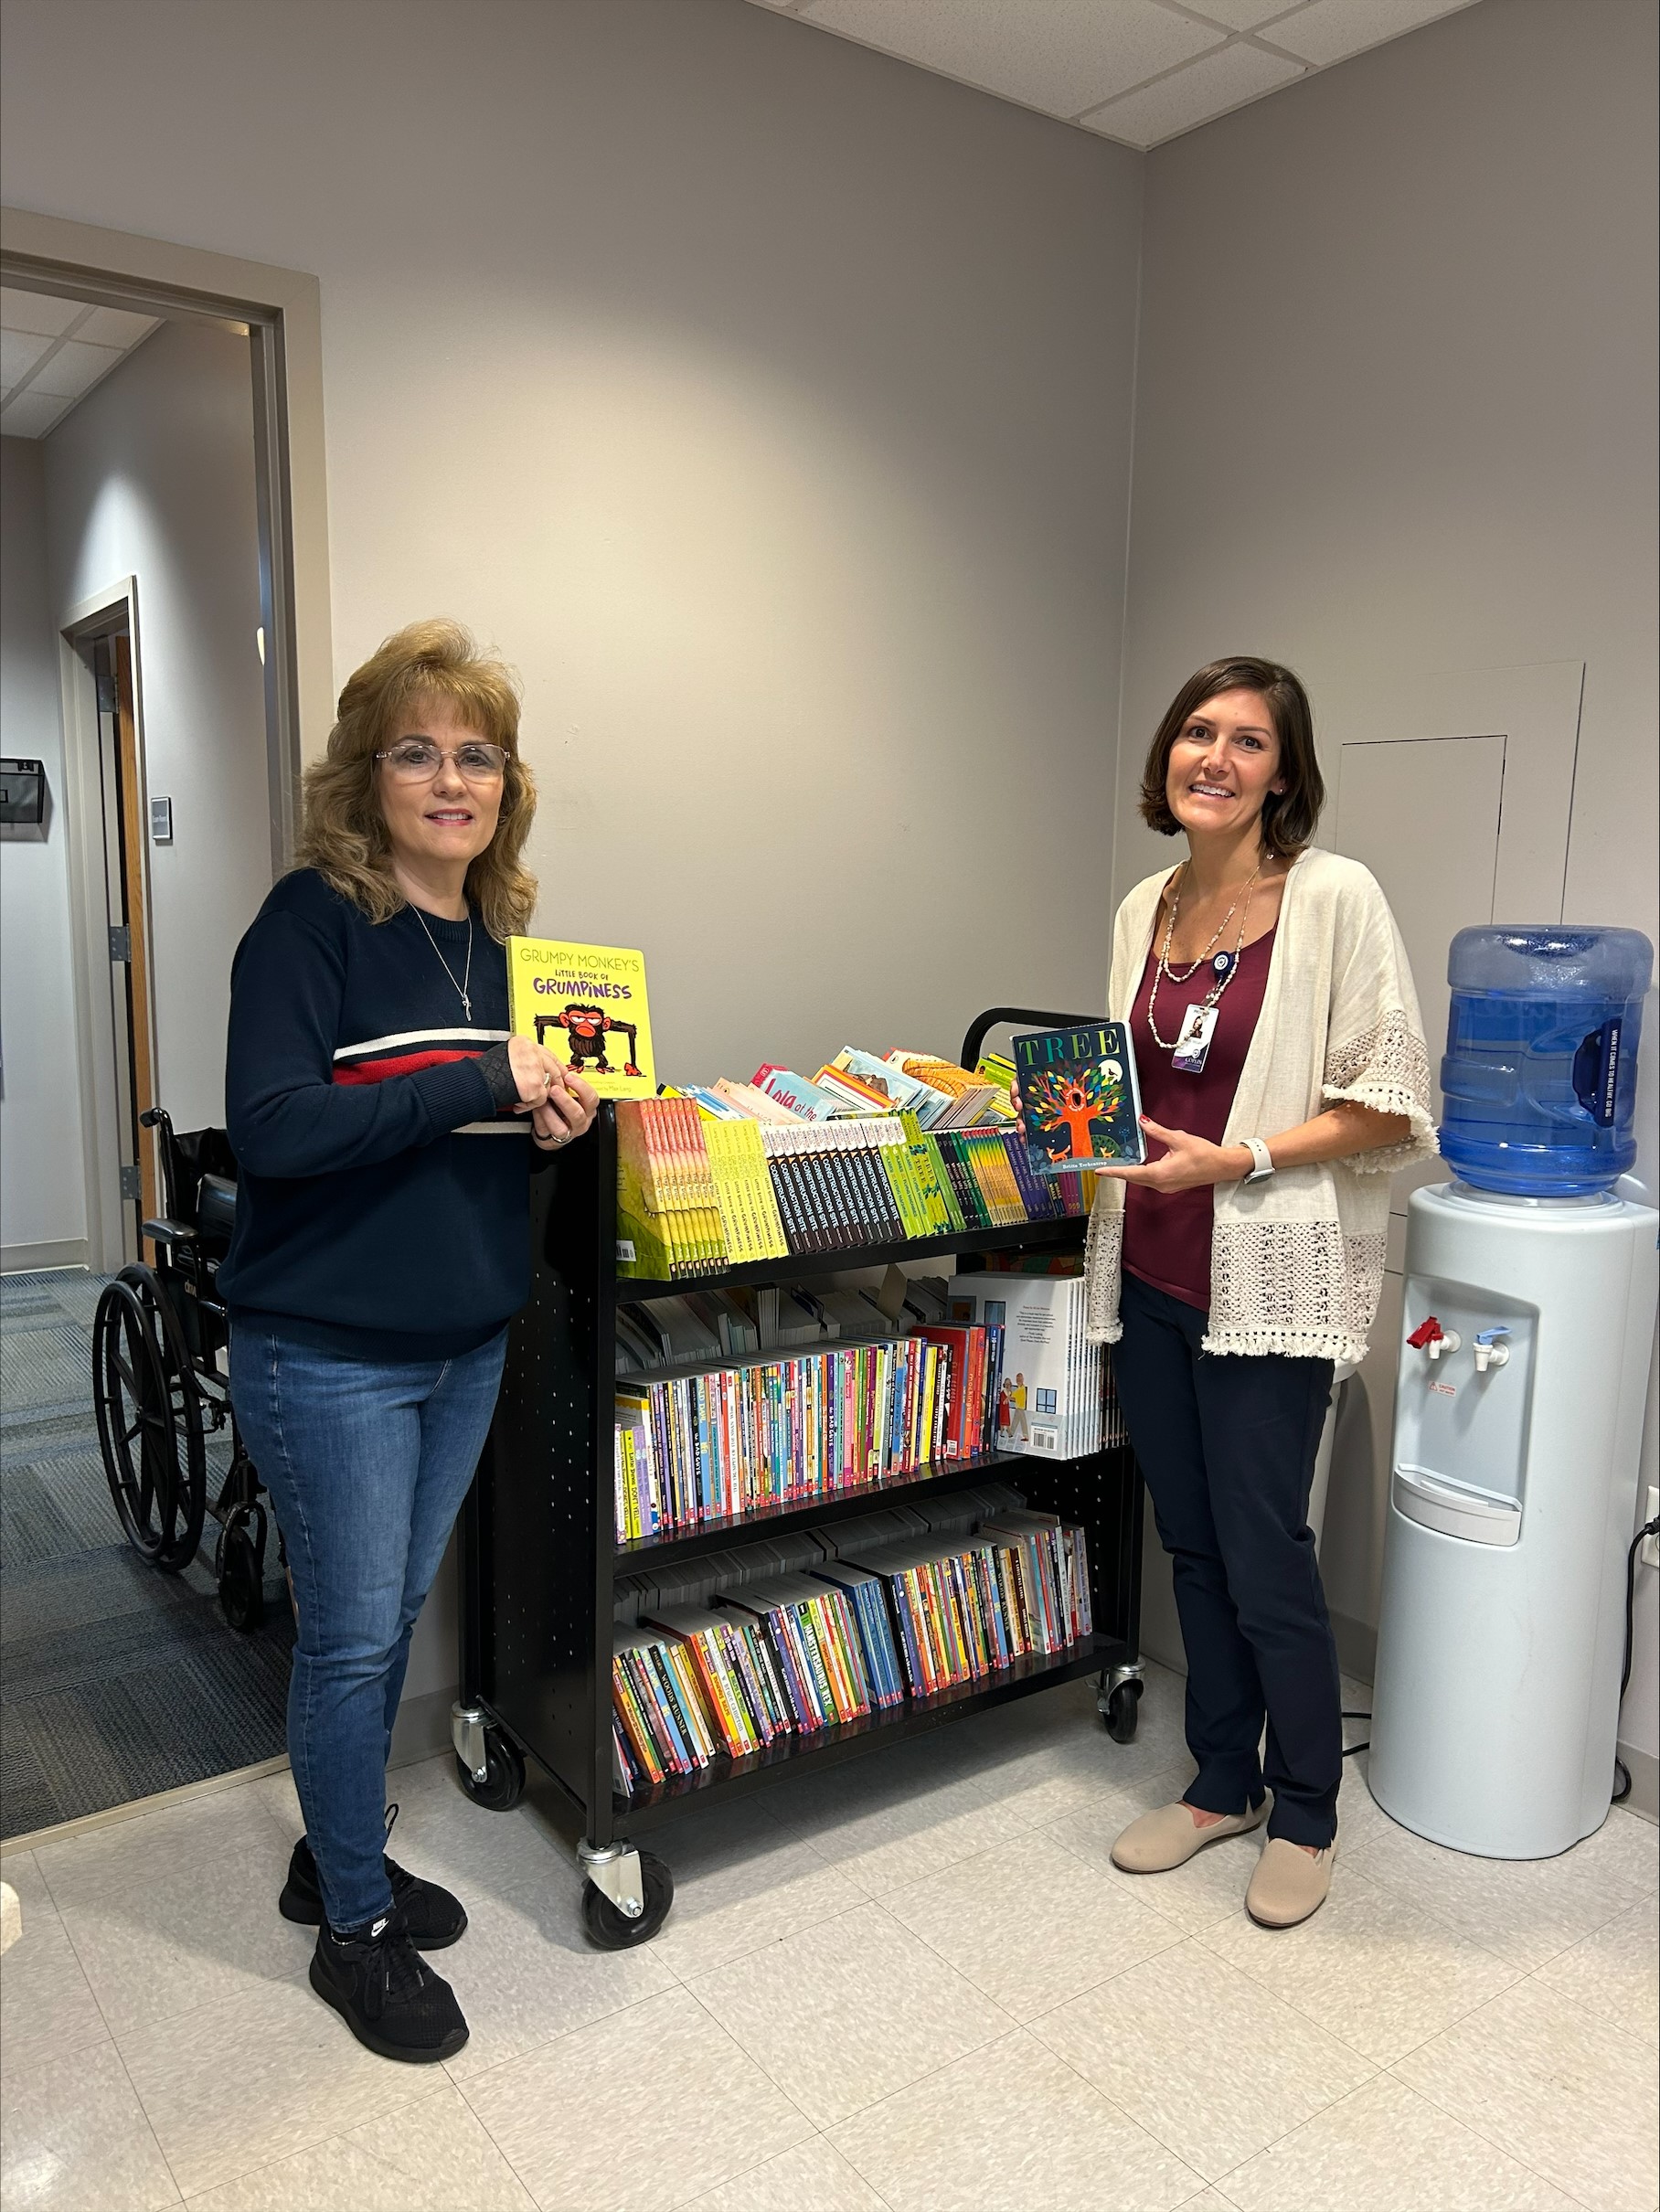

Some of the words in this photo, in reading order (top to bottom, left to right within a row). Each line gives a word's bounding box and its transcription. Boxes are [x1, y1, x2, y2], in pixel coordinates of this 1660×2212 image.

[520, 948, 573, 965] GRUMPY
[578, 954, 639, 972] MONKEY'S
[579, 971, 598, 980] BOOK
[533, 977, 632, 999] GRUMPINESS
[1018, 1028, 1120, 1066] TREE
[794, 1103, 806, 1113] at
[804, 1106, 817, 1122] the
[873, 1154, 895, 1205] CONSTRUCTION
[889, 1205, 899, 1220] SITE
[915, 1160, 926, 1183] TREE
[923, 1158, 935, 1182] TREE
[769, 1164, 792, 1218] CONSTRUCTION
[786, 1218, 796, 1234] SITE
[780, 1162, 802, 1217] CONSTRUCTION
[796, 1216, 807, 1232] SITE
[791, 1162, 813, 1215] CONSTRUCTION
[808, 1214, 818, 1231] SITE
[801, 1159, 824, 1214] CONSTRUCTION
[818, 1213, 828, 1229] SITE
[812, 1159, 833, 1212] CONSTRUCTION
[828, 1211, 839, 1228] SITE
[822, 1158, 843, 1211] CONSTRUCTION
[839, 1210, 849, 1227] SITE
[832, 1156, 854, 1209] CONSTRUCTION
[849, 1208, 859, 1225] SITE
[843, 1156, 864, 1208] CONSTRUCTION
[860, 1208, 869, 1224] SITE
[853, 1155, 874, 1207] CONSTRUCTION
[869, 1207, 879, 1223] SITE
[863, 1154, 884, 1207] CONSTRUCTION
[879, 1206, 889, 1221] SITE
[1048, 1183, 1057, 1200] WHALE
[1054, 1181, 1062, 1199] WHALE
[696, 1377, 705, 1401] ROALD
[965, 1373, 974, 1422] mockingbird
[697, 1403, 706, 1423] DAHL
[995, 1572, 1006, 1599] WOODS
[999, 1601, 1011, 1631] RUNNER
[802, 1622, 828, 1689] HAMSTERSAURUS
[820, 1689, 833, 1707] REX
[820, 1643, 834, 1674] superfudge
[648, 1671, 660, 1690] DAHL
[660, 1674, 676, 1702] WOODS
[671, 1704, 687, 1736] RUNNER
[373, 1918, 386, 1930] NIKE
